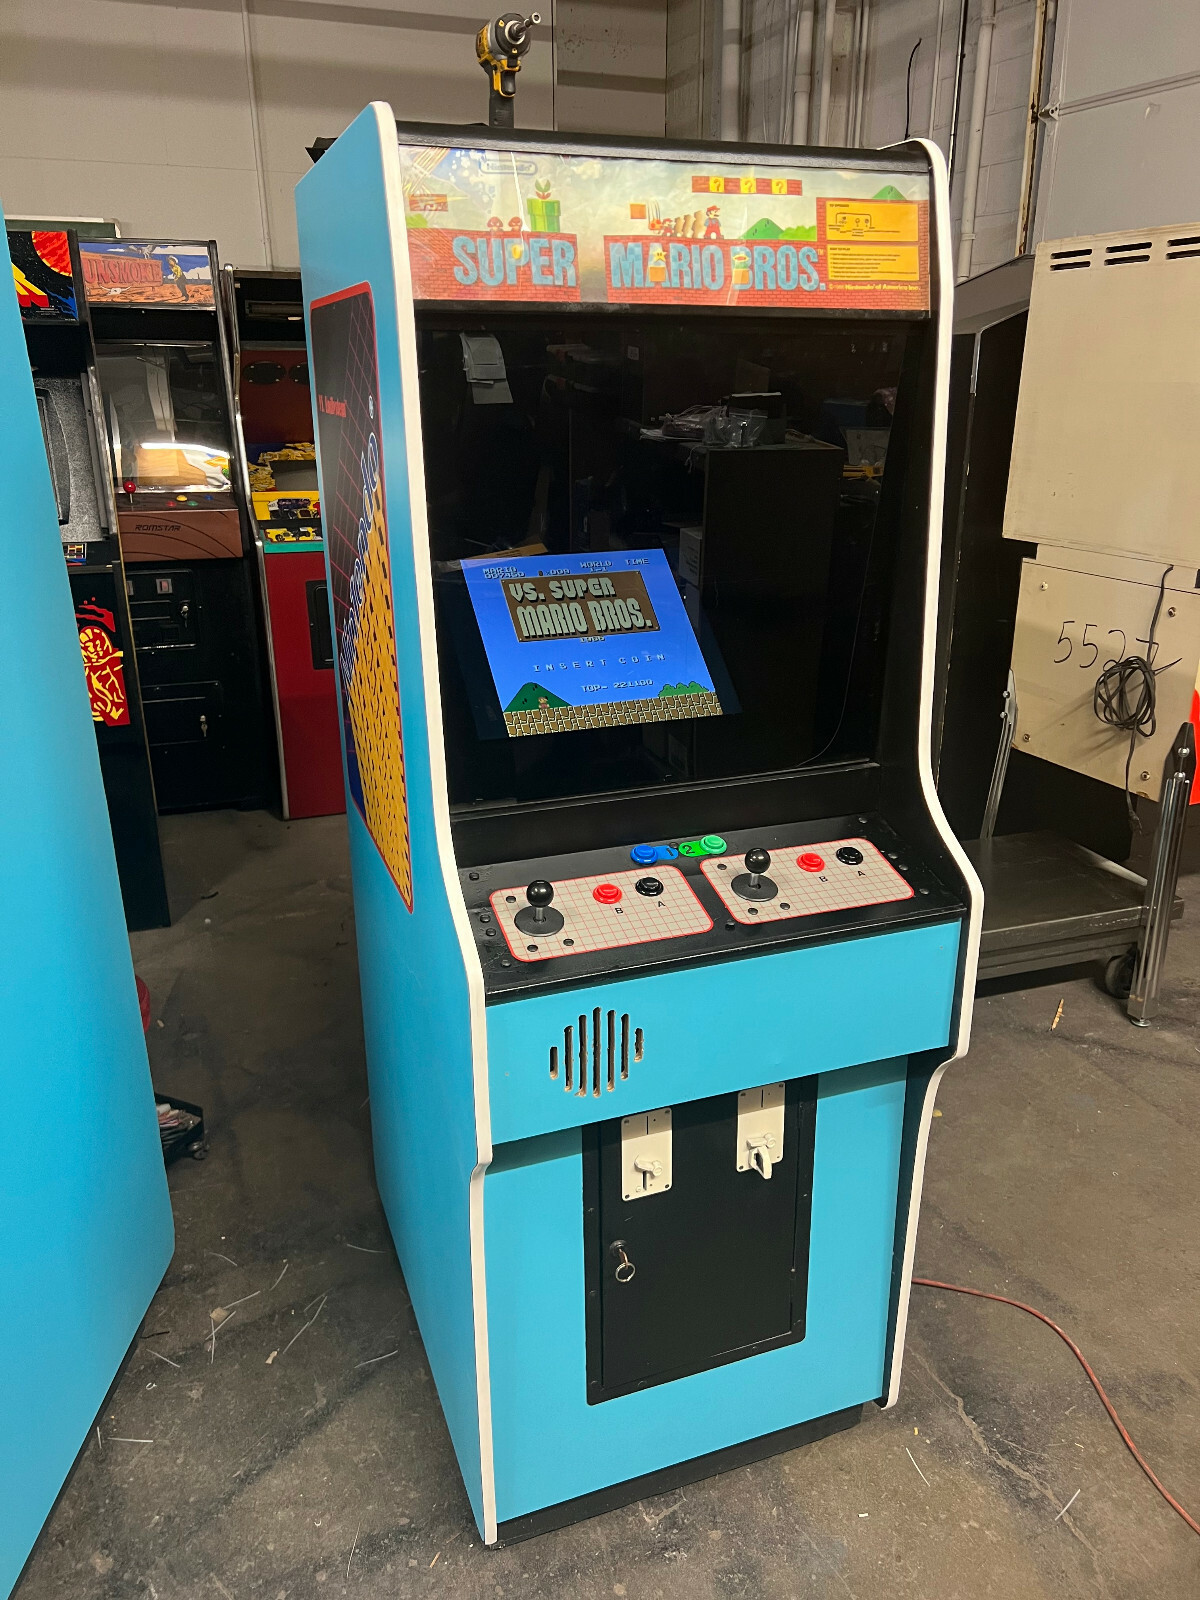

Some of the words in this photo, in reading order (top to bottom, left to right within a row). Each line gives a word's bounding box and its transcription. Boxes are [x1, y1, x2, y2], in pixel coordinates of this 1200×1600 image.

[82, 258, 161, 284] UNSMOKE
[452, 236, 577, 287] SUPER
[609, 242, 724, 291] MARIO
[731, 245, 826, 292] BROS.
[135, 524, 182, 532] ROMSTAR
[580, 560, 613, 568] WORLD
[625, 558, 650, 566] TIME
[508, 581, 546, 602] VS.
[549, 577, 616, 599] SUPER
[516, 601, 589, 639] MARIO
[588, 597, 653, 633] BROS.
[533, 659, 608, 672] INSERT
[619, 653, 667, 664] COIN
[682, 844, 696, 855] 2
[657, 900, 666, 908] A
